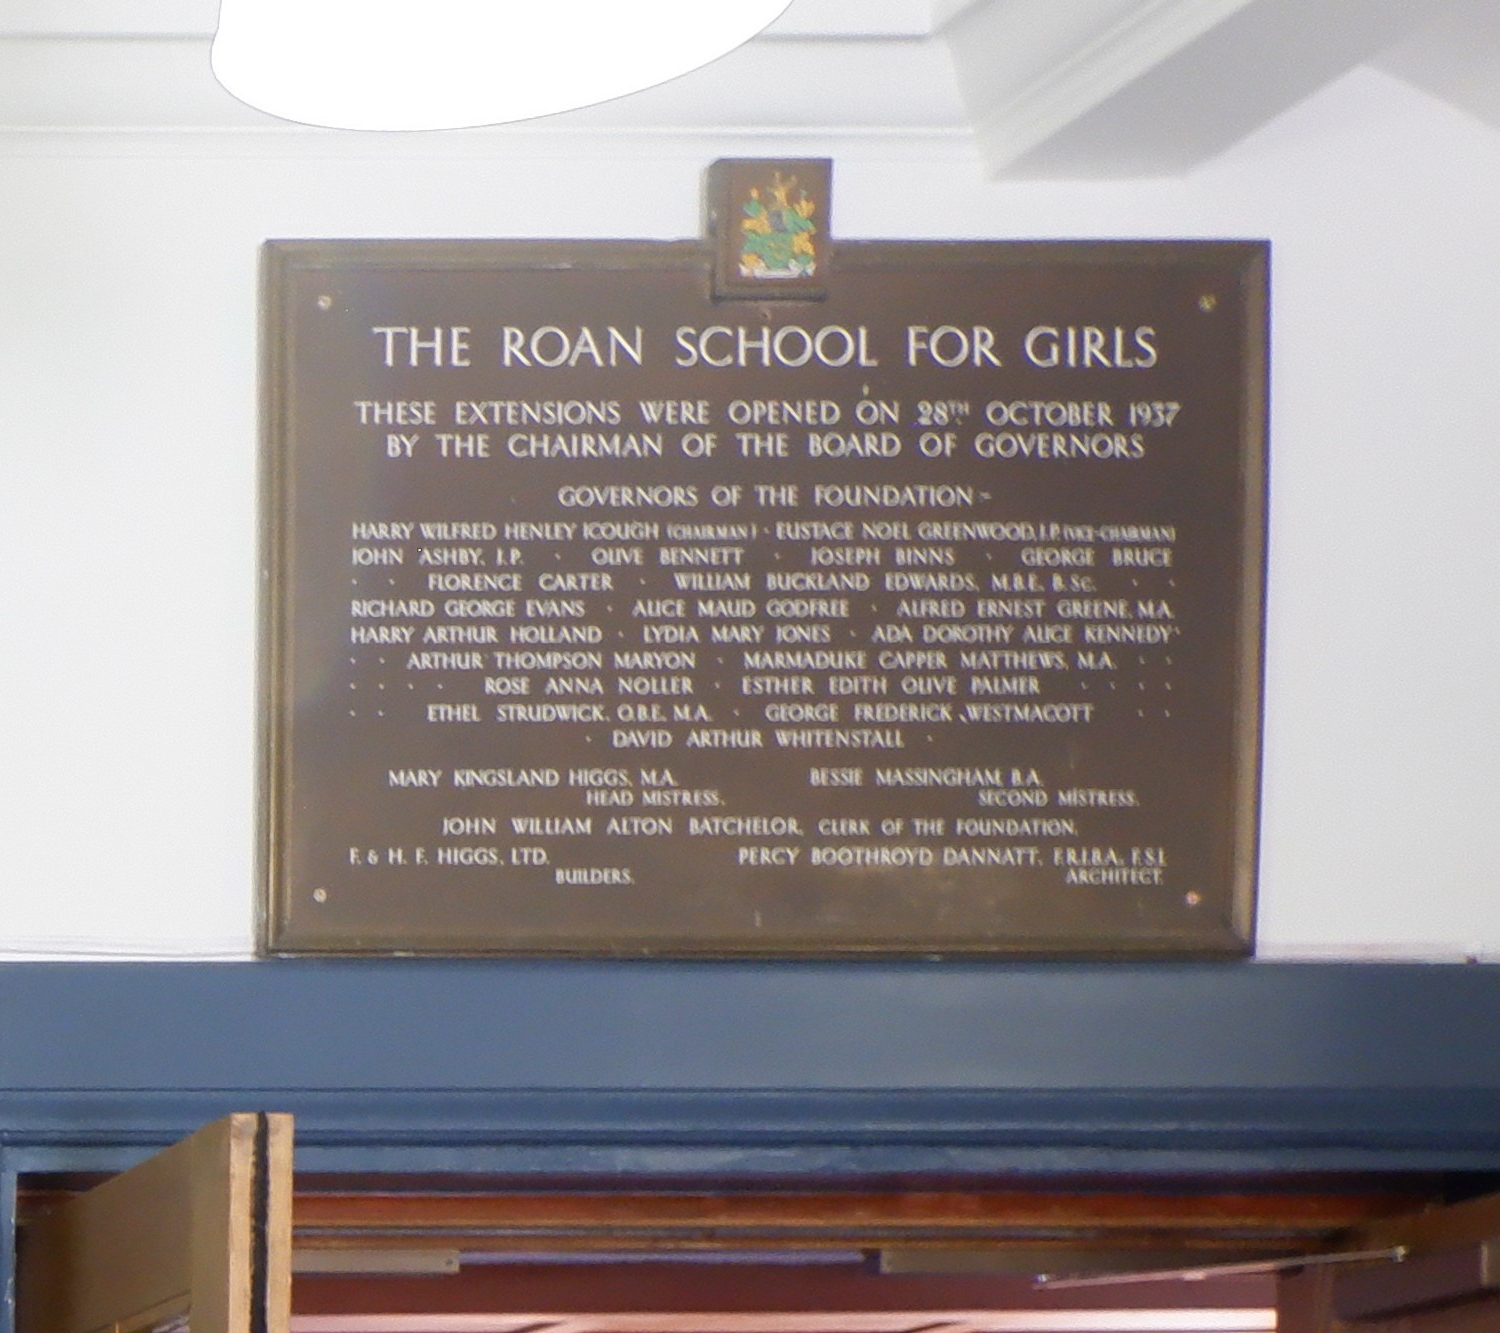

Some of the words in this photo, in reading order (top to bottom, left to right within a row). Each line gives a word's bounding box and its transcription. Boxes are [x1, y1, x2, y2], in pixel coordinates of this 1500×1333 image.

[372, 326, 471, 367] THE
[503, 326, 643, 367] ROAN
[676, 325, 878, 367] SCHOOL
[908, 325, 1002, 367] FOR
[1024, 326, 1157, 368] GIRLS
[354, 401, 436, 425] THESE
[455, 400, 621, 425] EXTENSIONS
[639, 400, 710, 424] WERE
[728, 400, 841, 425] OPENED
[855, 400, 900, 425] ON
[985, 401, 1114, 426] OCTOBER
[1128, 401, 1181, 427] 1937
[387, 434, 419, 458] BY
[435, 433, 489, 458] THE
[507, 433, 663, 458] CHAIRMAN
[681, 433, 717, 457] OF
[736, 433, 788, 457] THE
[808, 432, 902, 457] BOARD
[919, 432, 957, 457] OF
[974, 433, 1145, 459] GOVERNORS
[558, 485, 699, 507] GOVERNORS
[711, 485, 742, 506] OF
[755, 485, 798, 506] THE
[352, 522, 414, 540] HARRY
[420, 522, 497, 540] WILFRED
[504, 522, 577, 540] HENLEY
[352, 547, 403, 565] JOHN
[591, 548, 644, 565] OLIVE
[659, 547, 744, 565] BENNETT
[811, 547, 880, 565] JOSEPH
[895, 547, 955, 565] BINNS
[1021, 548, 1095, 566] GEORGE
[1112, 548, 1172, 566] BRUCE
[428, 573, 522, 591] FLORENCE
[538, 573, 613, 591] CARTER
[674, 573, 751, 590] WILLIAM
[766, 572, 870, 591] BUCKLAND
[351, 599, 435, 617] RICHARD
[444, 600, 515, 617] GEORGE
[526, 599, 585, 617] EVANS
[632, 599, 685, 617] ALICE
[698, 599, 756, 617] MAUD
[896, 599, 966, 618] ALFRED
[977, 599, 1045, 618] ERNEST
[351, 626, 414, 643] HARRY
[423, 625, 498, 643] ARTHUR
[510, 625, 603, 643] HOLLAND
[643, 625, 699, 643] LYDIA
[711, 625, 764, 643] MARY
[775, 625, 831, 643] JONES
[871, 624, 913, 643] ADA
[923, 625, 1013, 643] DOROTHY
[1023, 625, 1072, 643] ALICE
[407, 652, 484, 670] ARTHUR
[494, 651, 602, 670] THOMPSON
[614, 651, 696, 670] MARYON
[485, 677, 530, 695] ROSE
[545, 677, 604, 695] ANNA
[618, 676, 694, 695] NOLLER
[742, 676, 814, 695] ESTHER
[829, 675, 887, 695] EDITH
[901, 676, 957, 695] OLIVE
[971, 676, 1041, 695] PALMER
[612, 730, 673, 748] DAVID
[686, 729, 763, 748] ARTHUR
[775, 729, 903, 748] WHITENSTALL
[442, 817, 496, 835] JOHN
[511, 817, 592, 835] WILLIAM
[606, 817, 673, 835] ALTON
[738, 847, 800, 866] PERCY
[811, 847, 934, 866] BOOTHROYD
